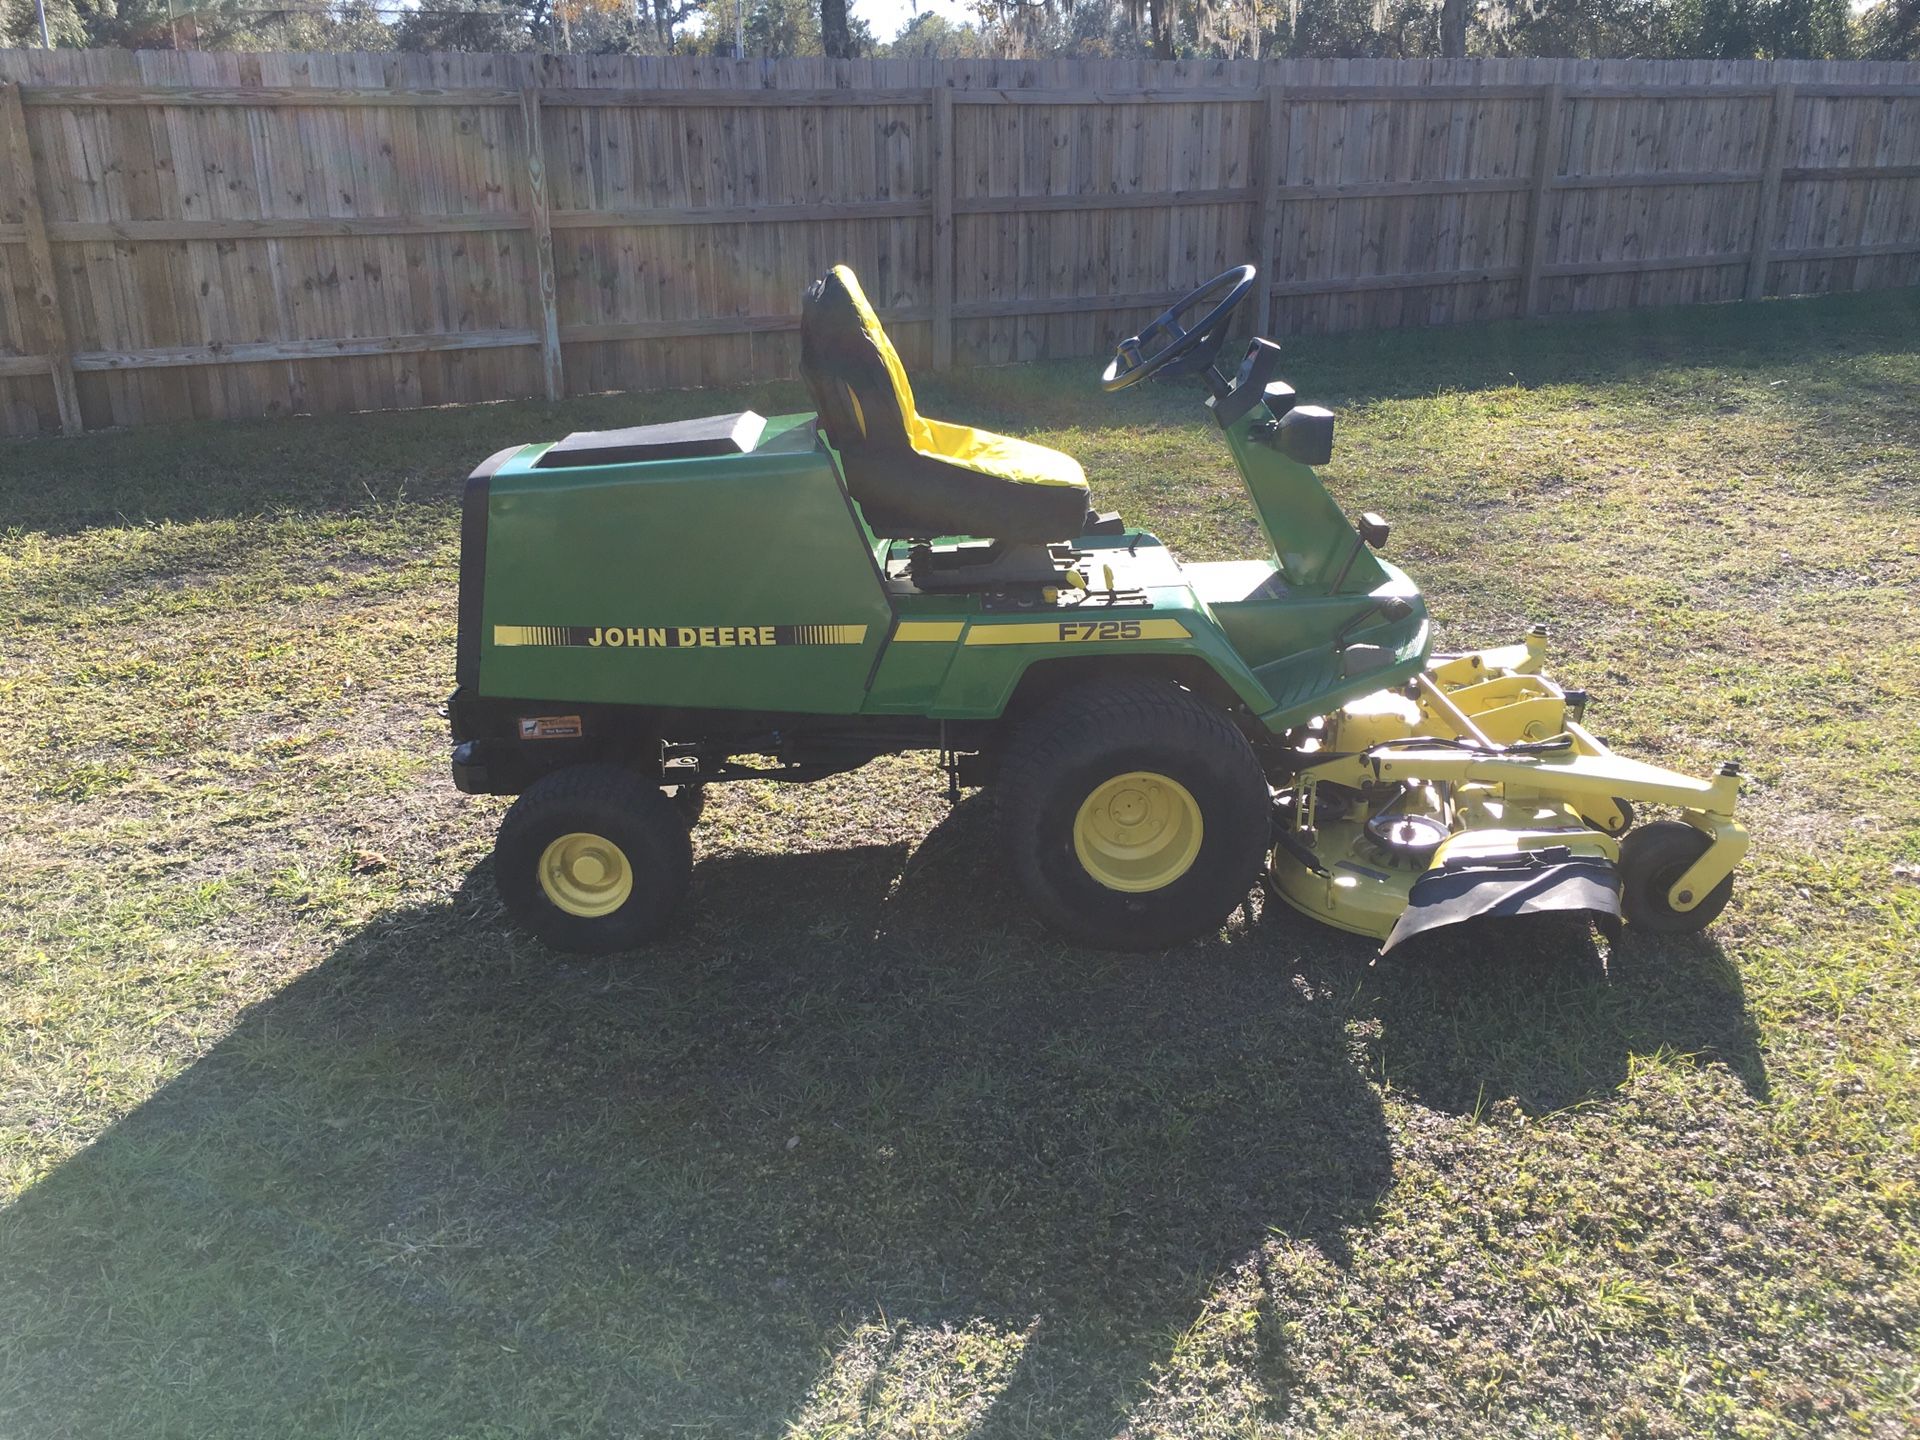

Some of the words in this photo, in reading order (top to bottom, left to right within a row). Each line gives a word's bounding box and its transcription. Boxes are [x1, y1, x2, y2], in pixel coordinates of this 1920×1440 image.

[588, 627, 667, 647] JOHN
[678, 626, 777, 647] DEERE
[1059, 621, 1141, 640] F725
